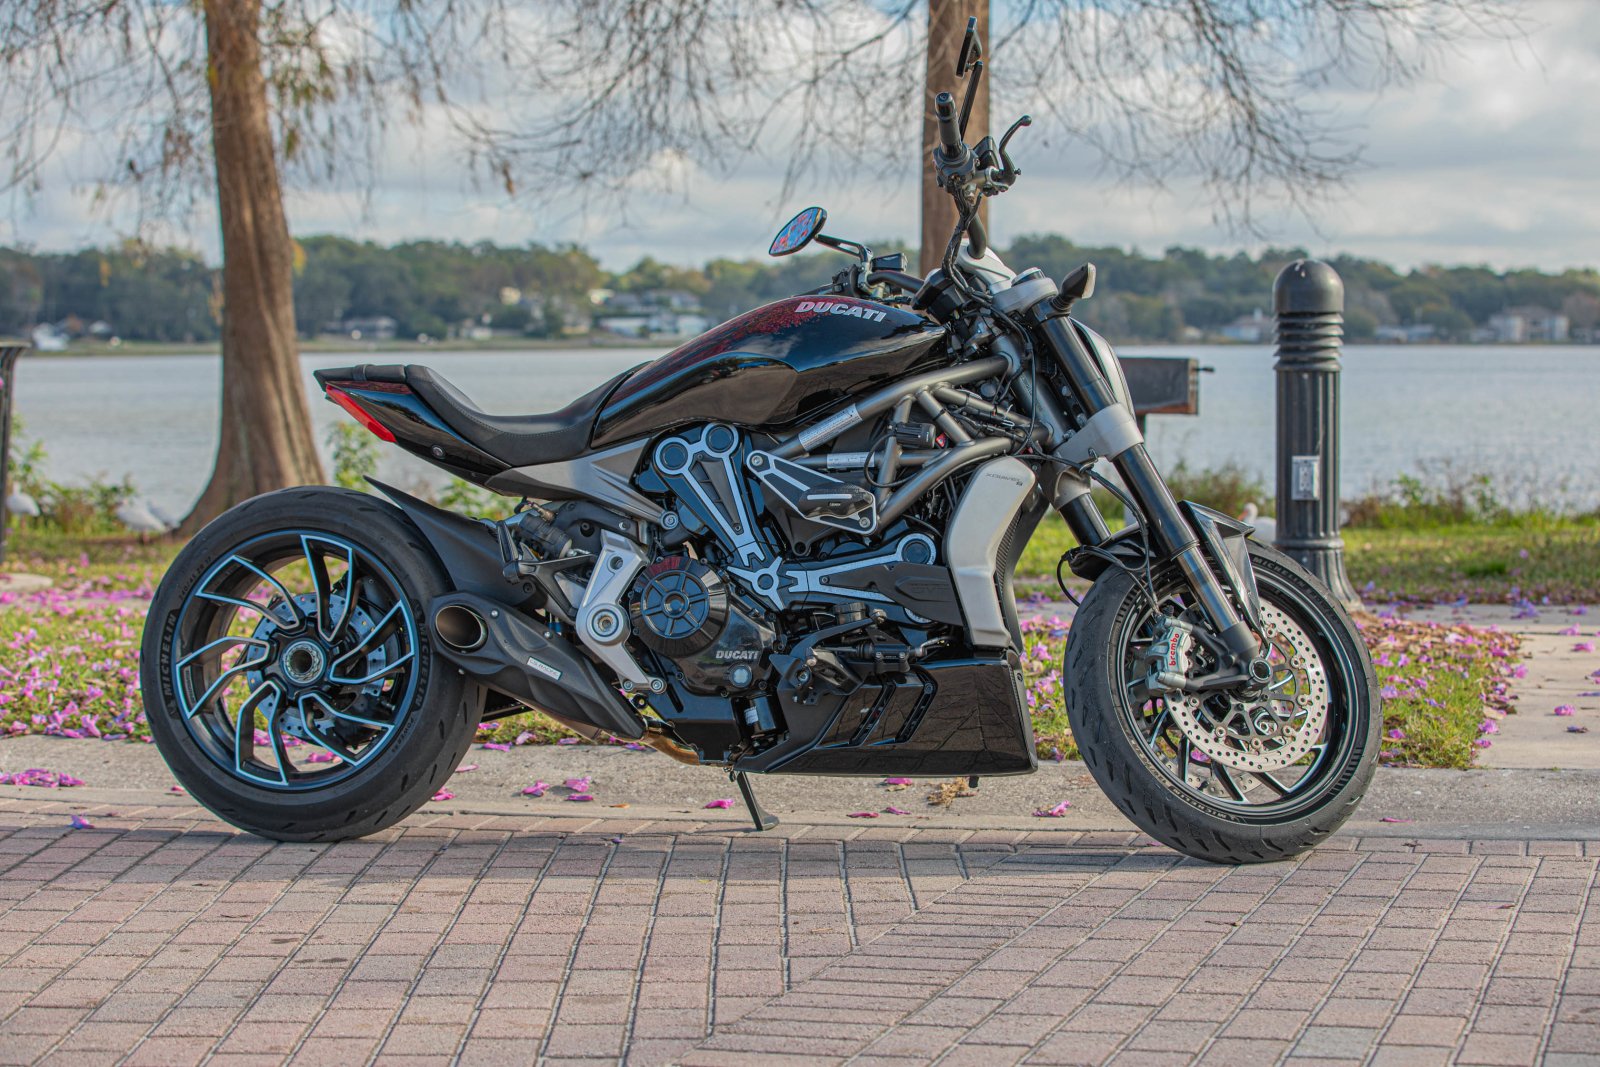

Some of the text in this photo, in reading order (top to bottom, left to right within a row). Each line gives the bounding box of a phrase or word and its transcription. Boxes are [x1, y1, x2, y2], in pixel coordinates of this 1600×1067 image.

[795, 301, 887, 323] DUCATI
[1252, 556, 1306, 588] MICHELIN
[160, 613, 177, 697] MICHELIN
[415, 623, 430, 707] MICHELIN
[715, 650, 760, 660] DUCATI
[1168, 633, 1180, 666] brembo
[1172, 788, 1227, 819] MICHELIN
